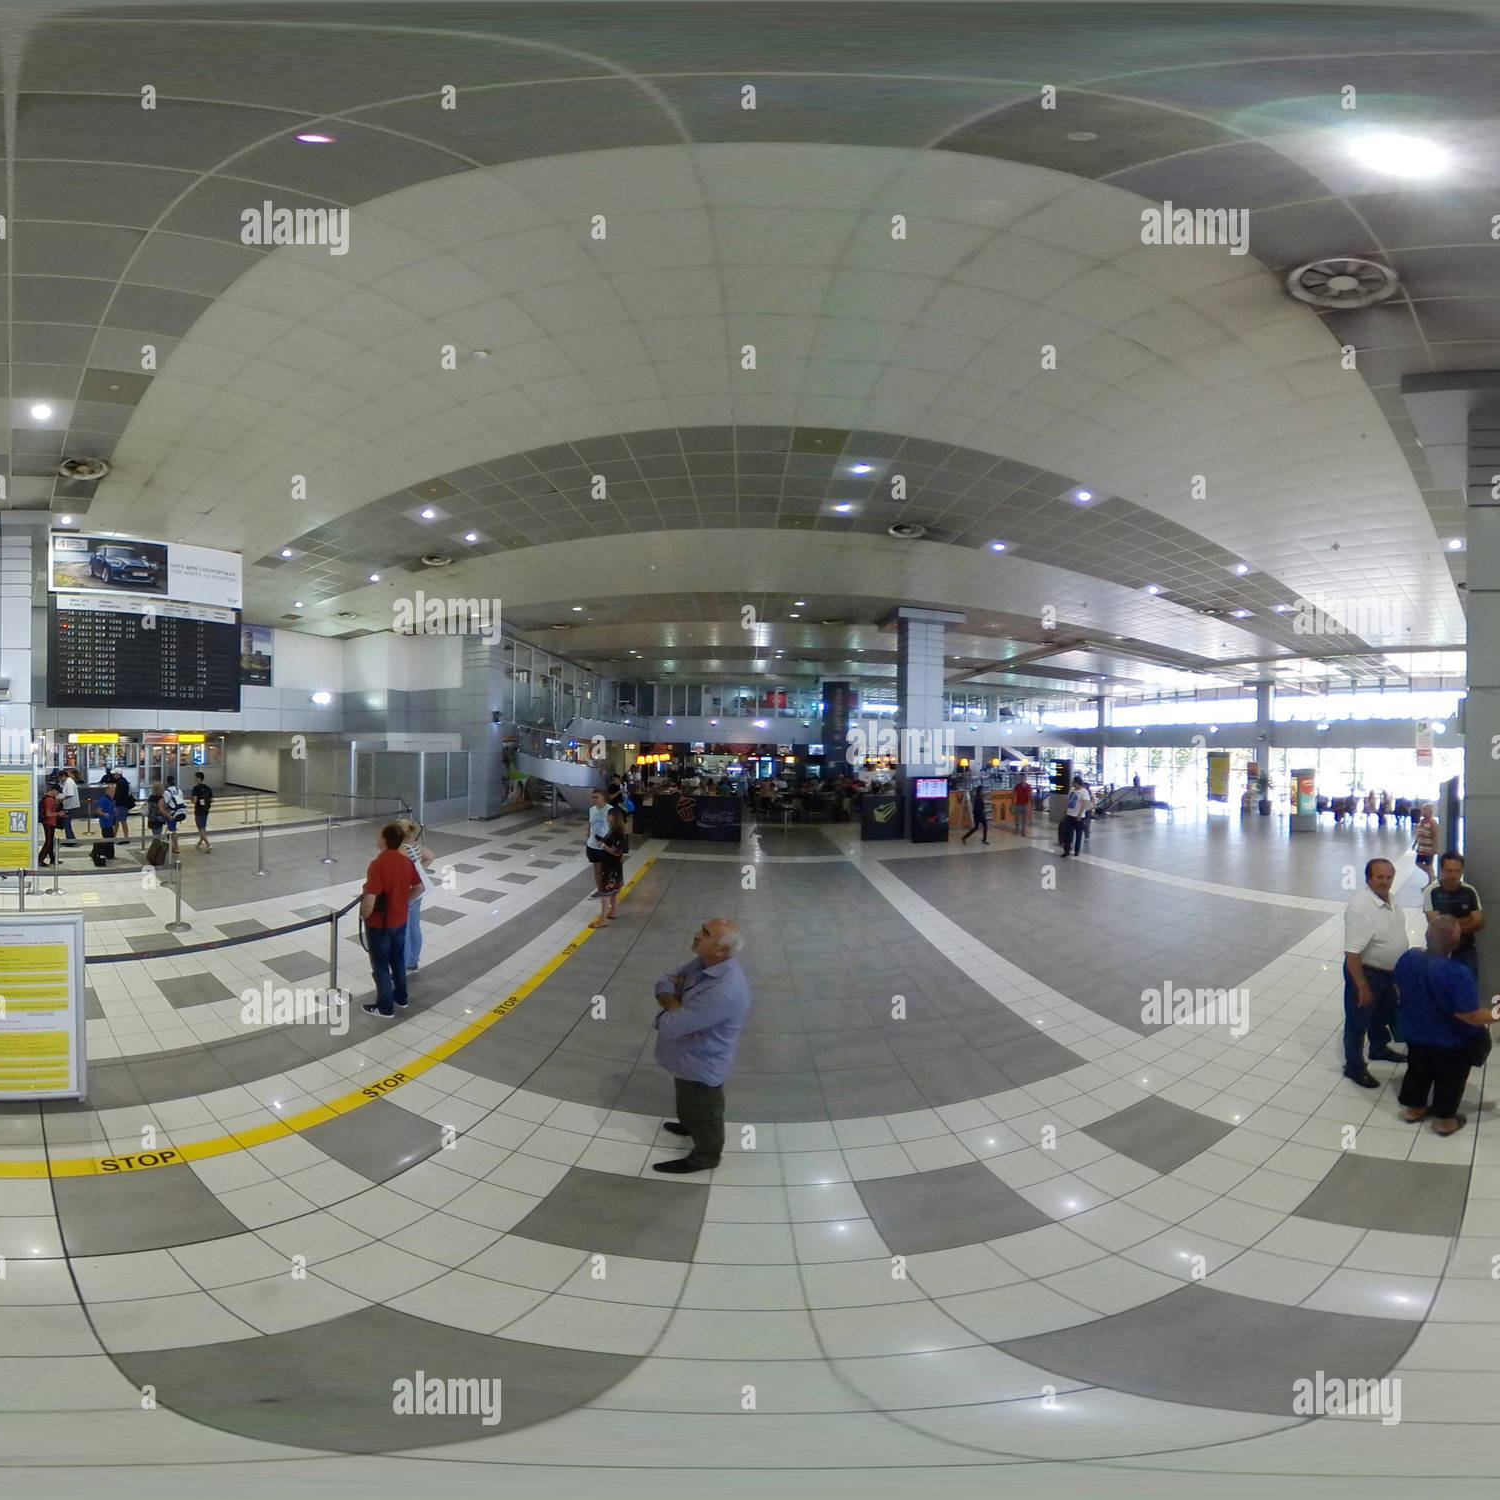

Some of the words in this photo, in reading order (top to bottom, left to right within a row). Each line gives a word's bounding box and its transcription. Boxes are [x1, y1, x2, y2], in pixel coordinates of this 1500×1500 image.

[492, 995, 519, 1016] STOP
[362, 1072, 406, 1099] STOP
[100, 1151, 176, 1172] STOP
